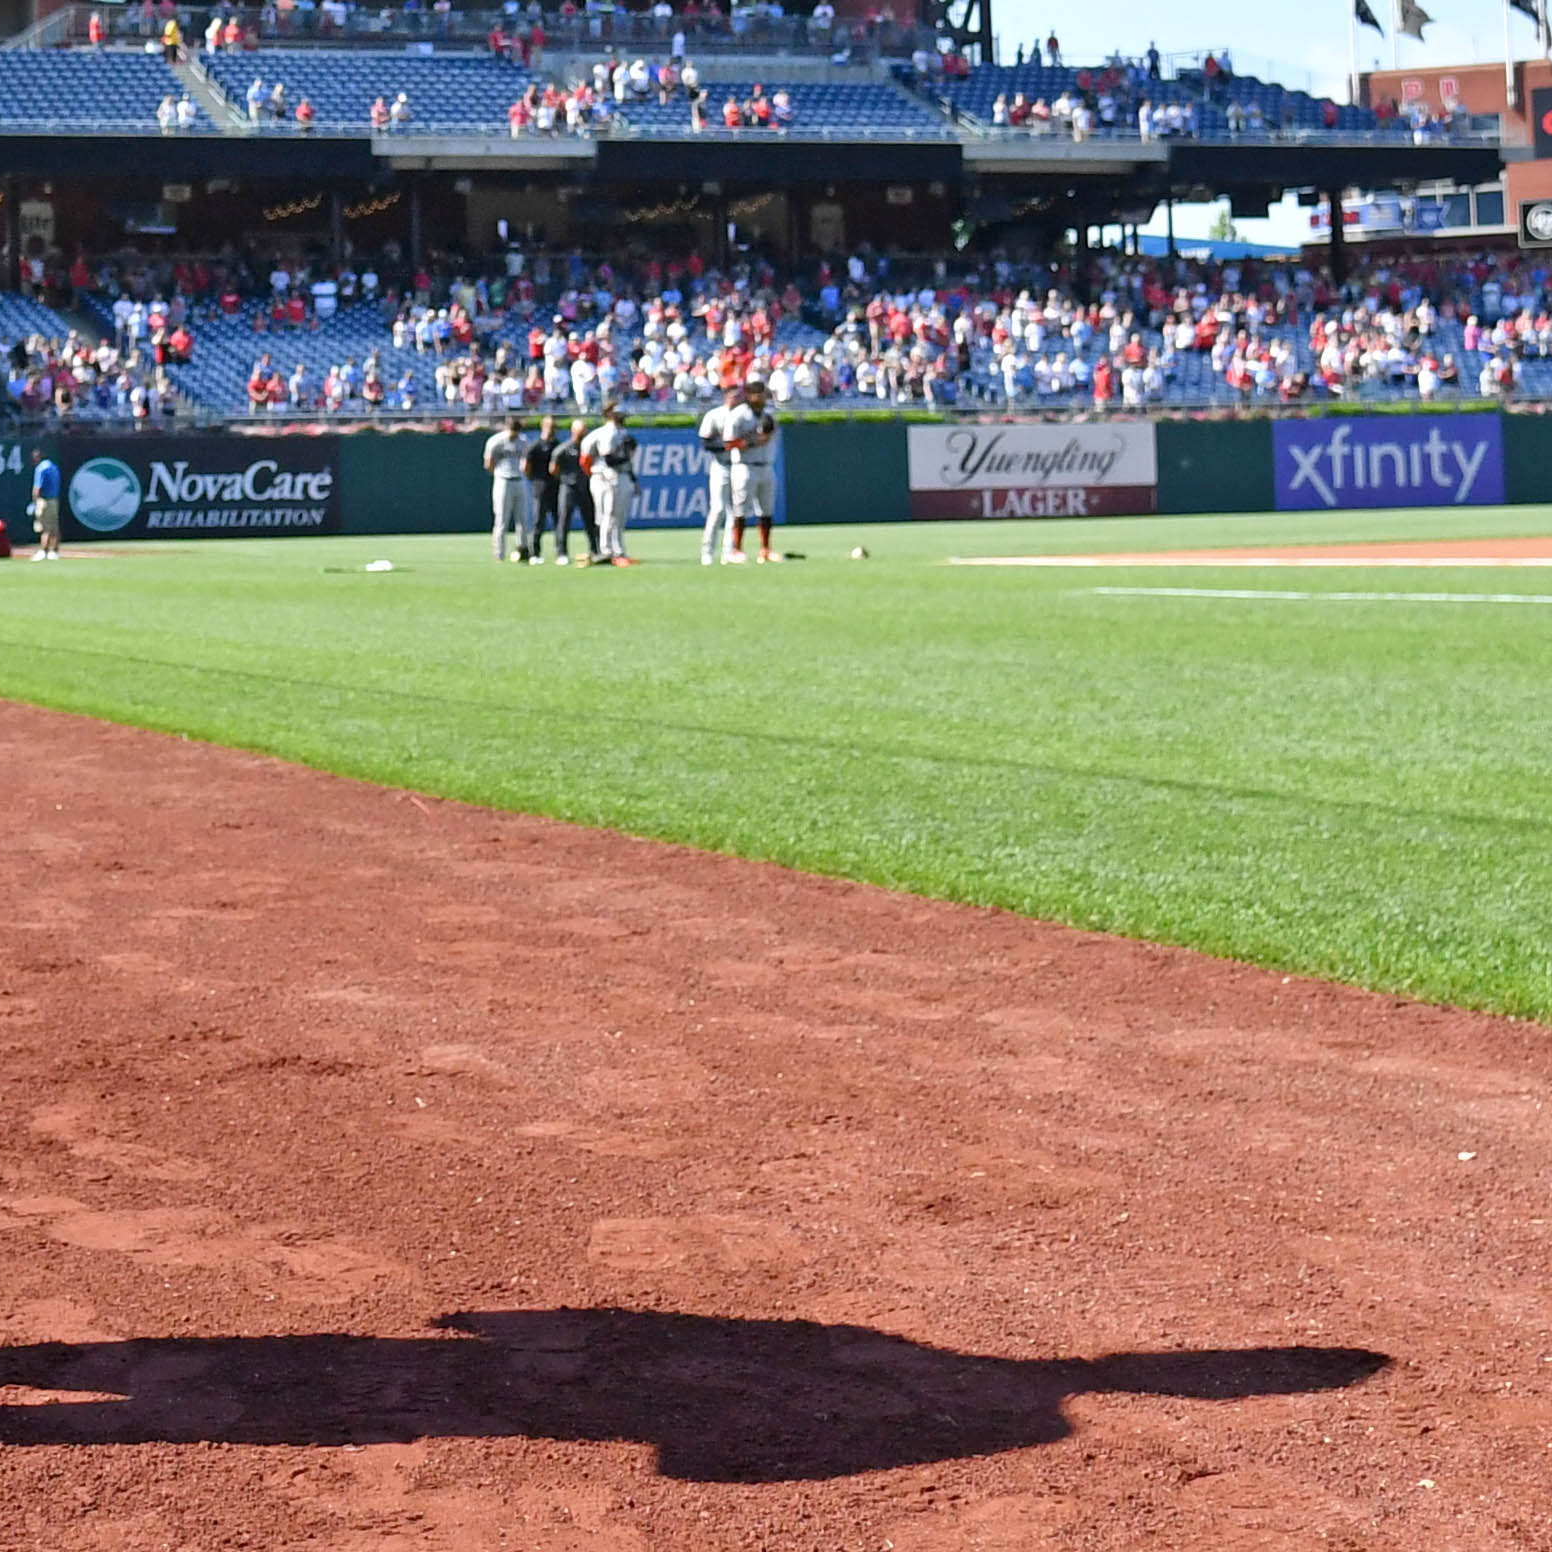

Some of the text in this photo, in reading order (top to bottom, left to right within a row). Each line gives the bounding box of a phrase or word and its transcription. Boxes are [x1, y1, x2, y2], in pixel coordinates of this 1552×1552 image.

[940, 430, 1126, 485] Yuengling
[1288, 426, 1489, 505] xfinity
[145, 460, 333, 503] NovaCare
[982, 488, 1088, 518] LAGER
[147, 507, 326, 529] REHABILITATION
